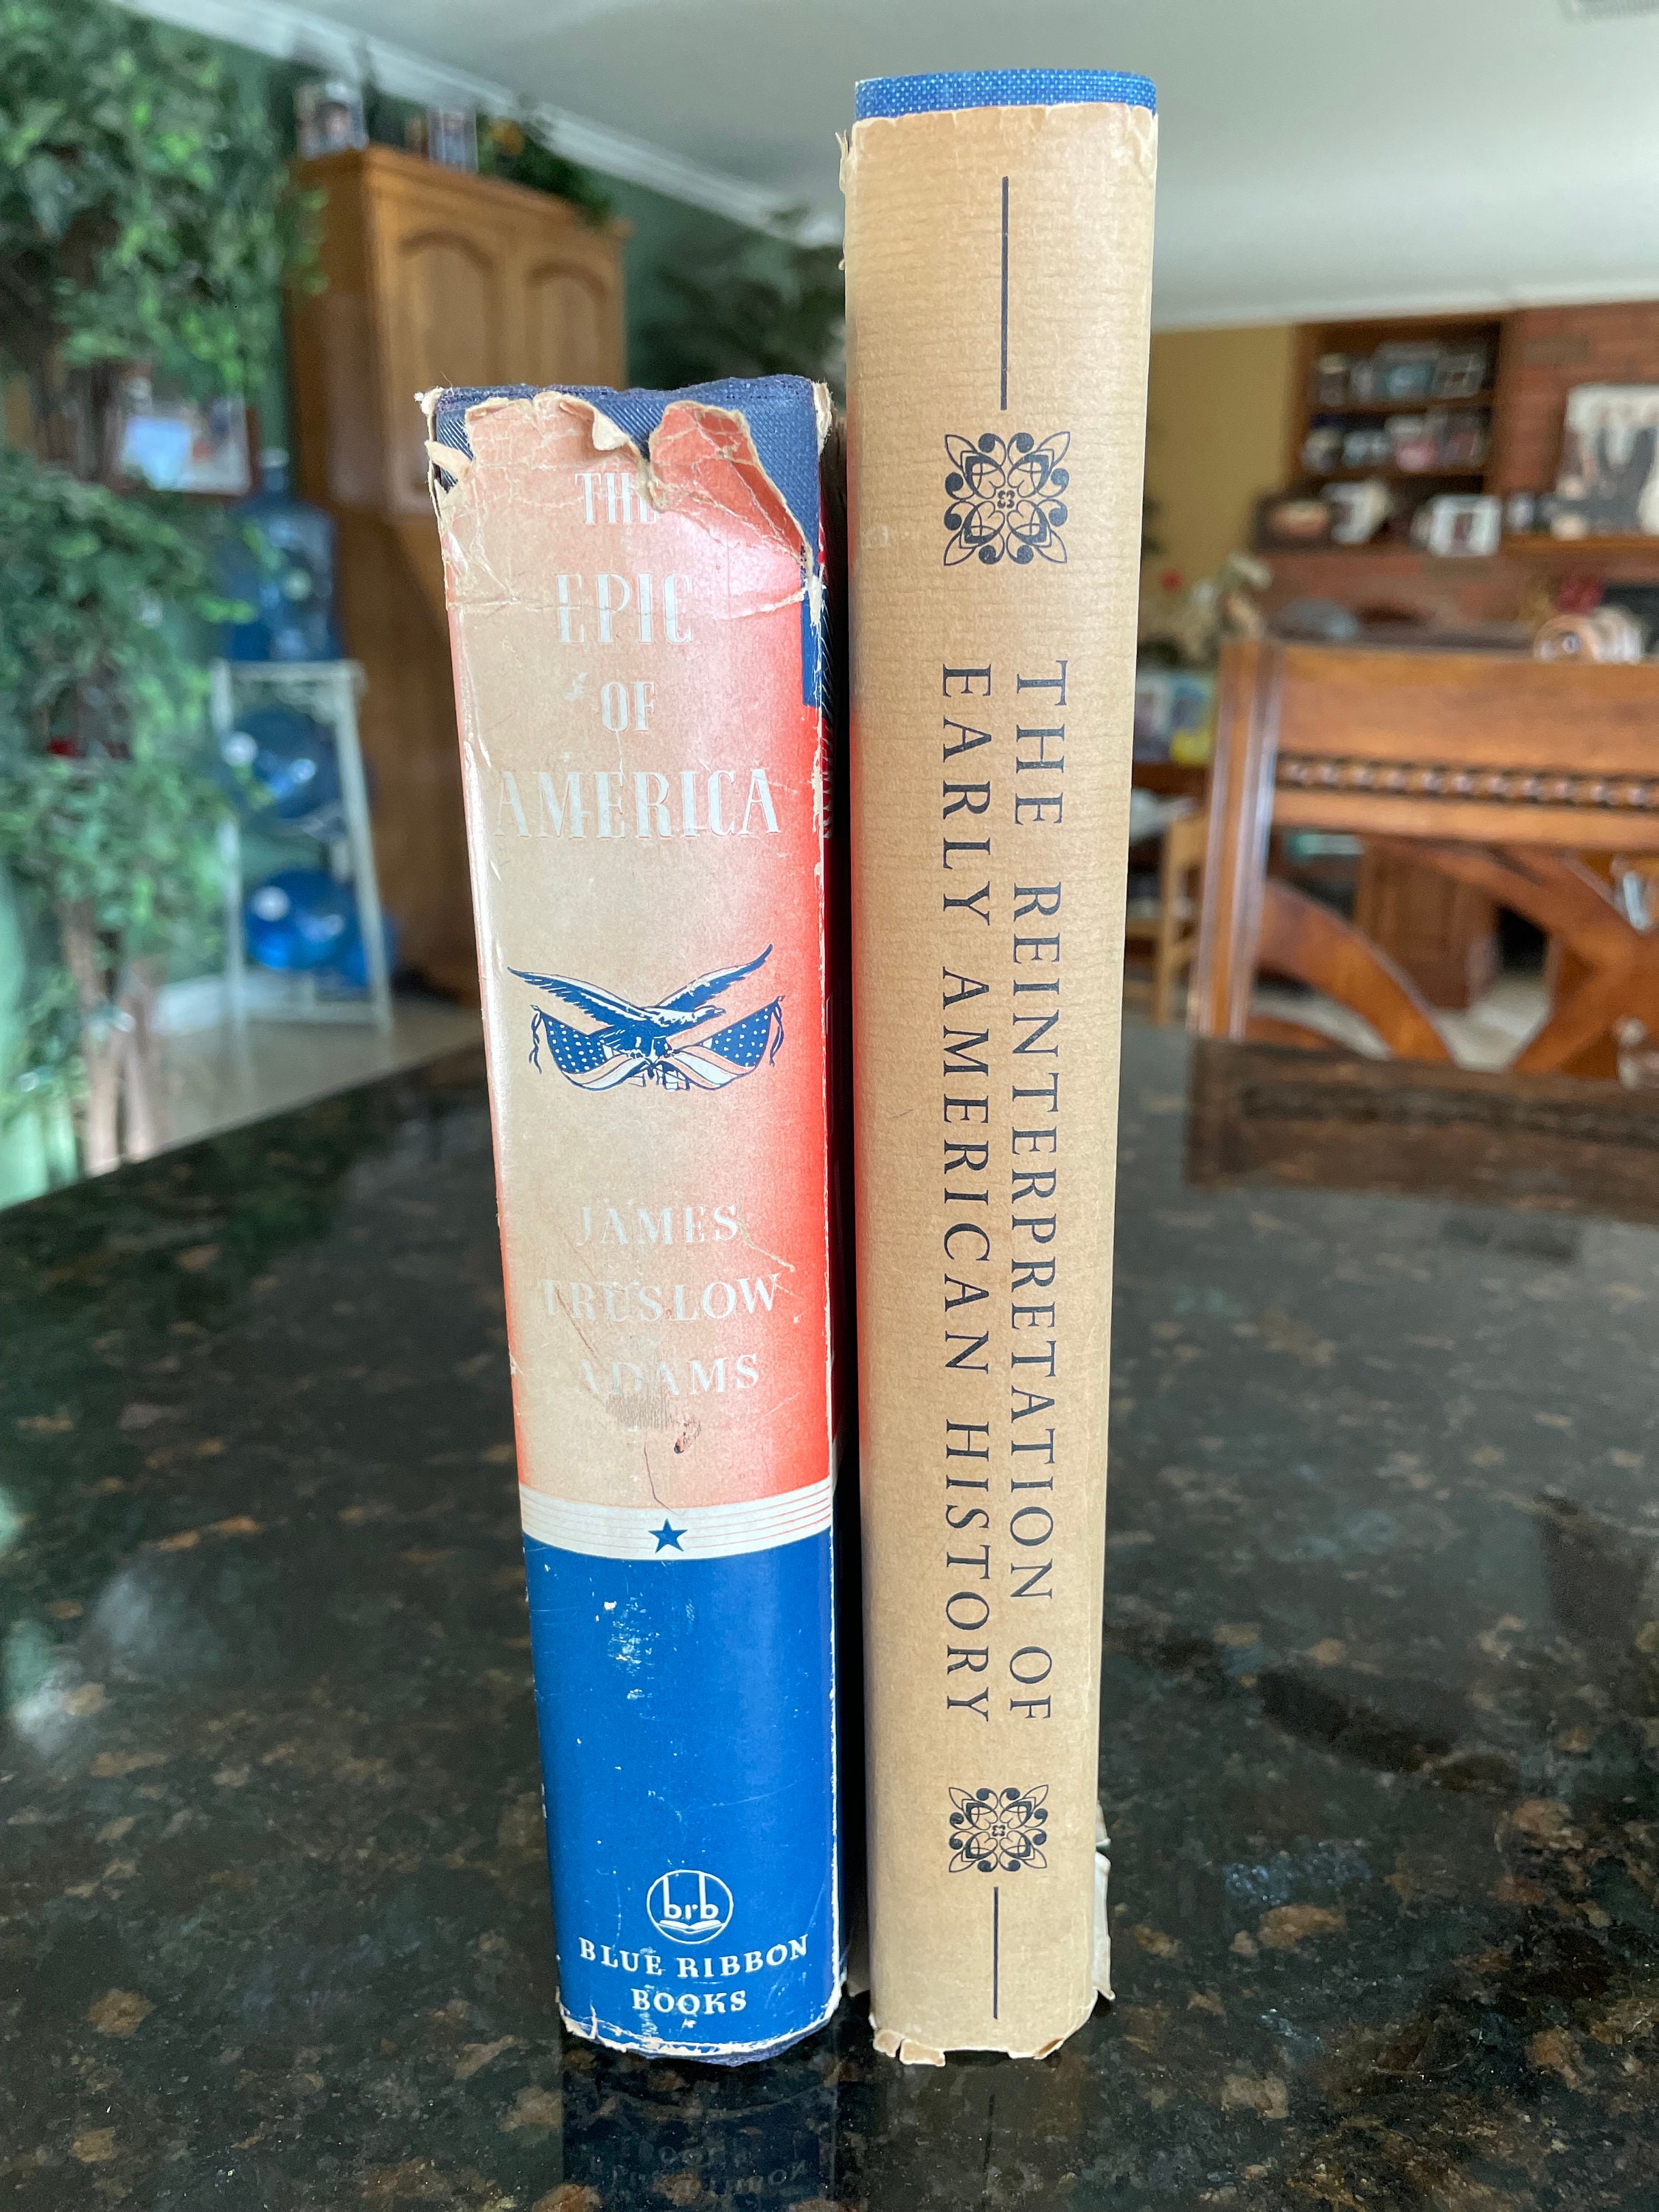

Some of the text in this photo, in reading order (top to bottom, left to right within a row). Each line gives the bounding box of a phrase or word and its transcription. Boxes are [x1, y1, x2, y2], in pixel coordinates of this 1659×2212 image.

[556, 572, 692, 644] EPIC
[600, 681, 655, 732] OF
[494, 768, 782, 839] AMERICA
[942, 663, 992, 1722] EARLY AMERICAN HISTORY
[1009, 659, 1068, 1720] THE REINTERPRETATION OF
[576, 1203, 738, 1248] JAMES
[538, 1273, 780, 1323] TRUSLOW
[662, 1872, 720, 1920] brb
[578, 1933, 809, 1978] BLUE RIBBON
[630, 1988, 747, 2016] BOOKS
